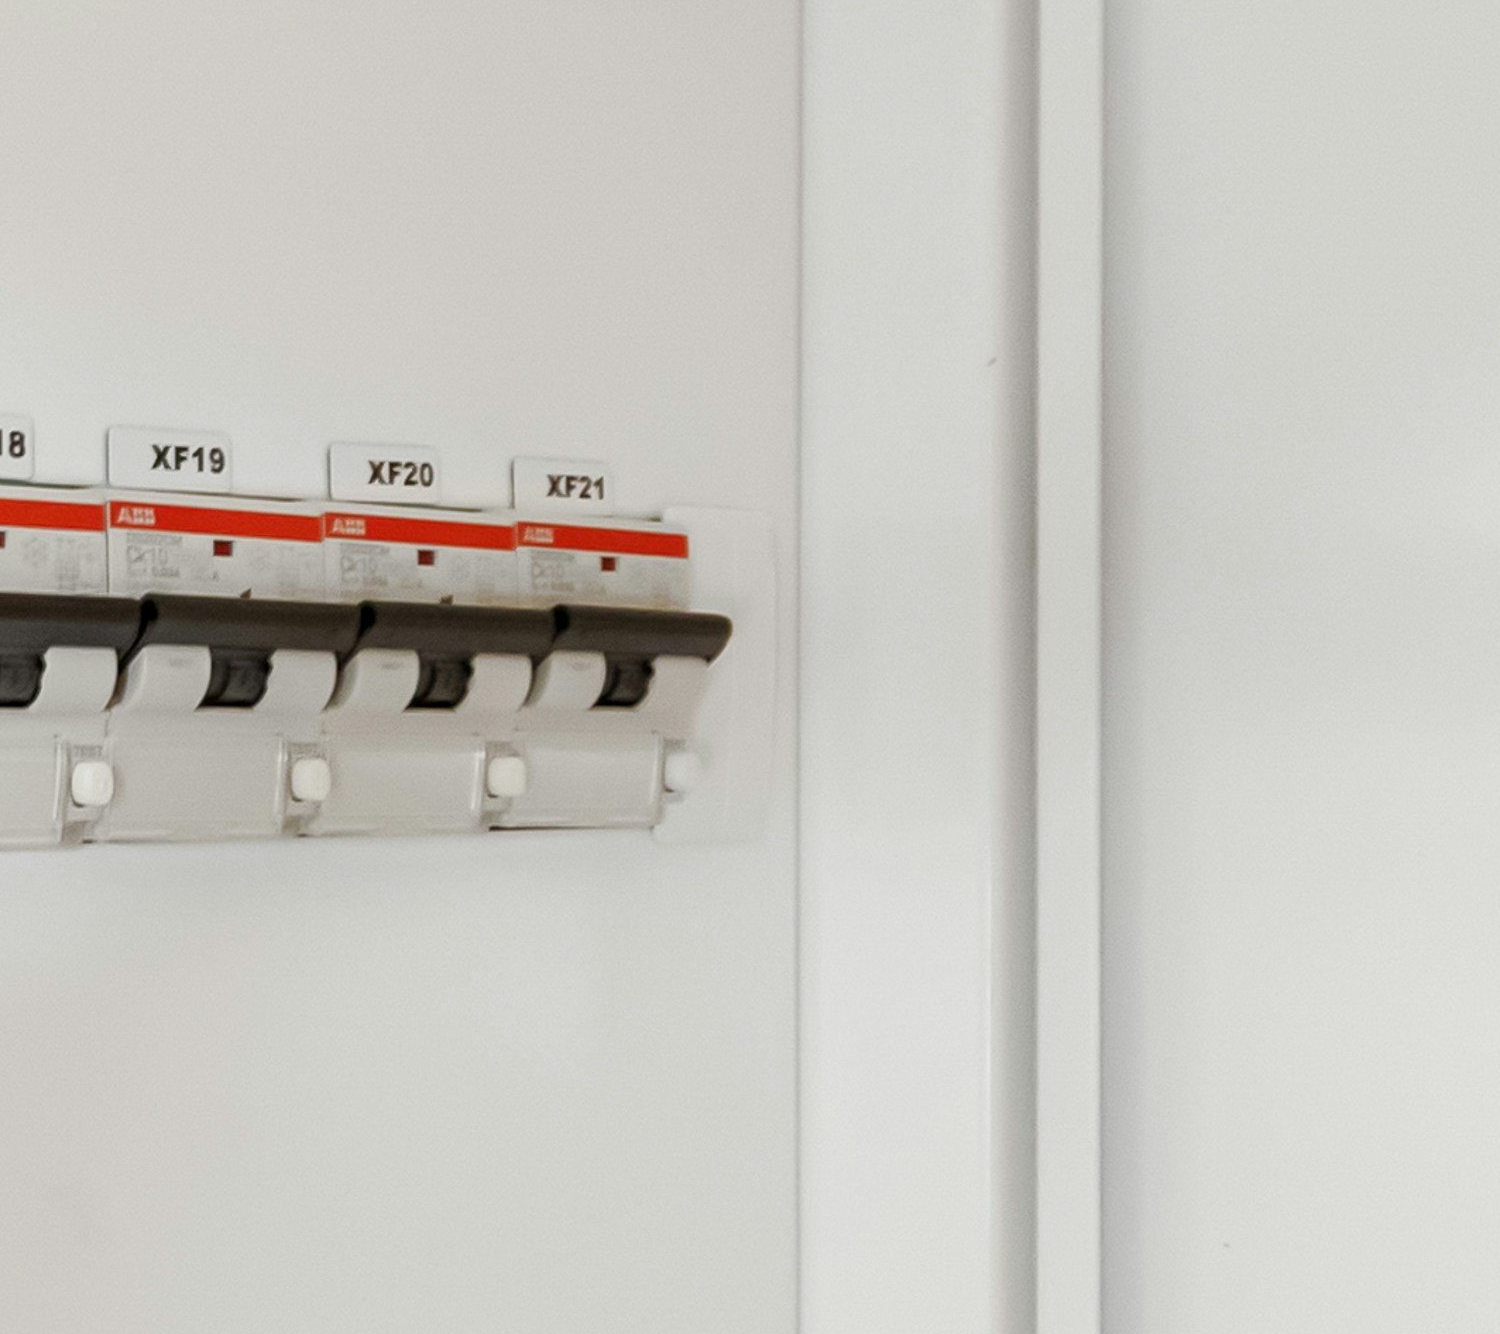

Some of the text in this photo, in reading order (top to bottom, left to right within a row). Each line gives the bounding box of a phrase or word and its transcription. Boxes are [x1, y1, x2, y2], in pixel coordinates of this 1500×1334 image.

[151, 444, 226, 474] XF19
[368, 460, 434, 488] XF20
[546, 474, 604, 500] XF21
[116, 506, 156, 526] ABB
[331, 517, 366, 536] ABB
